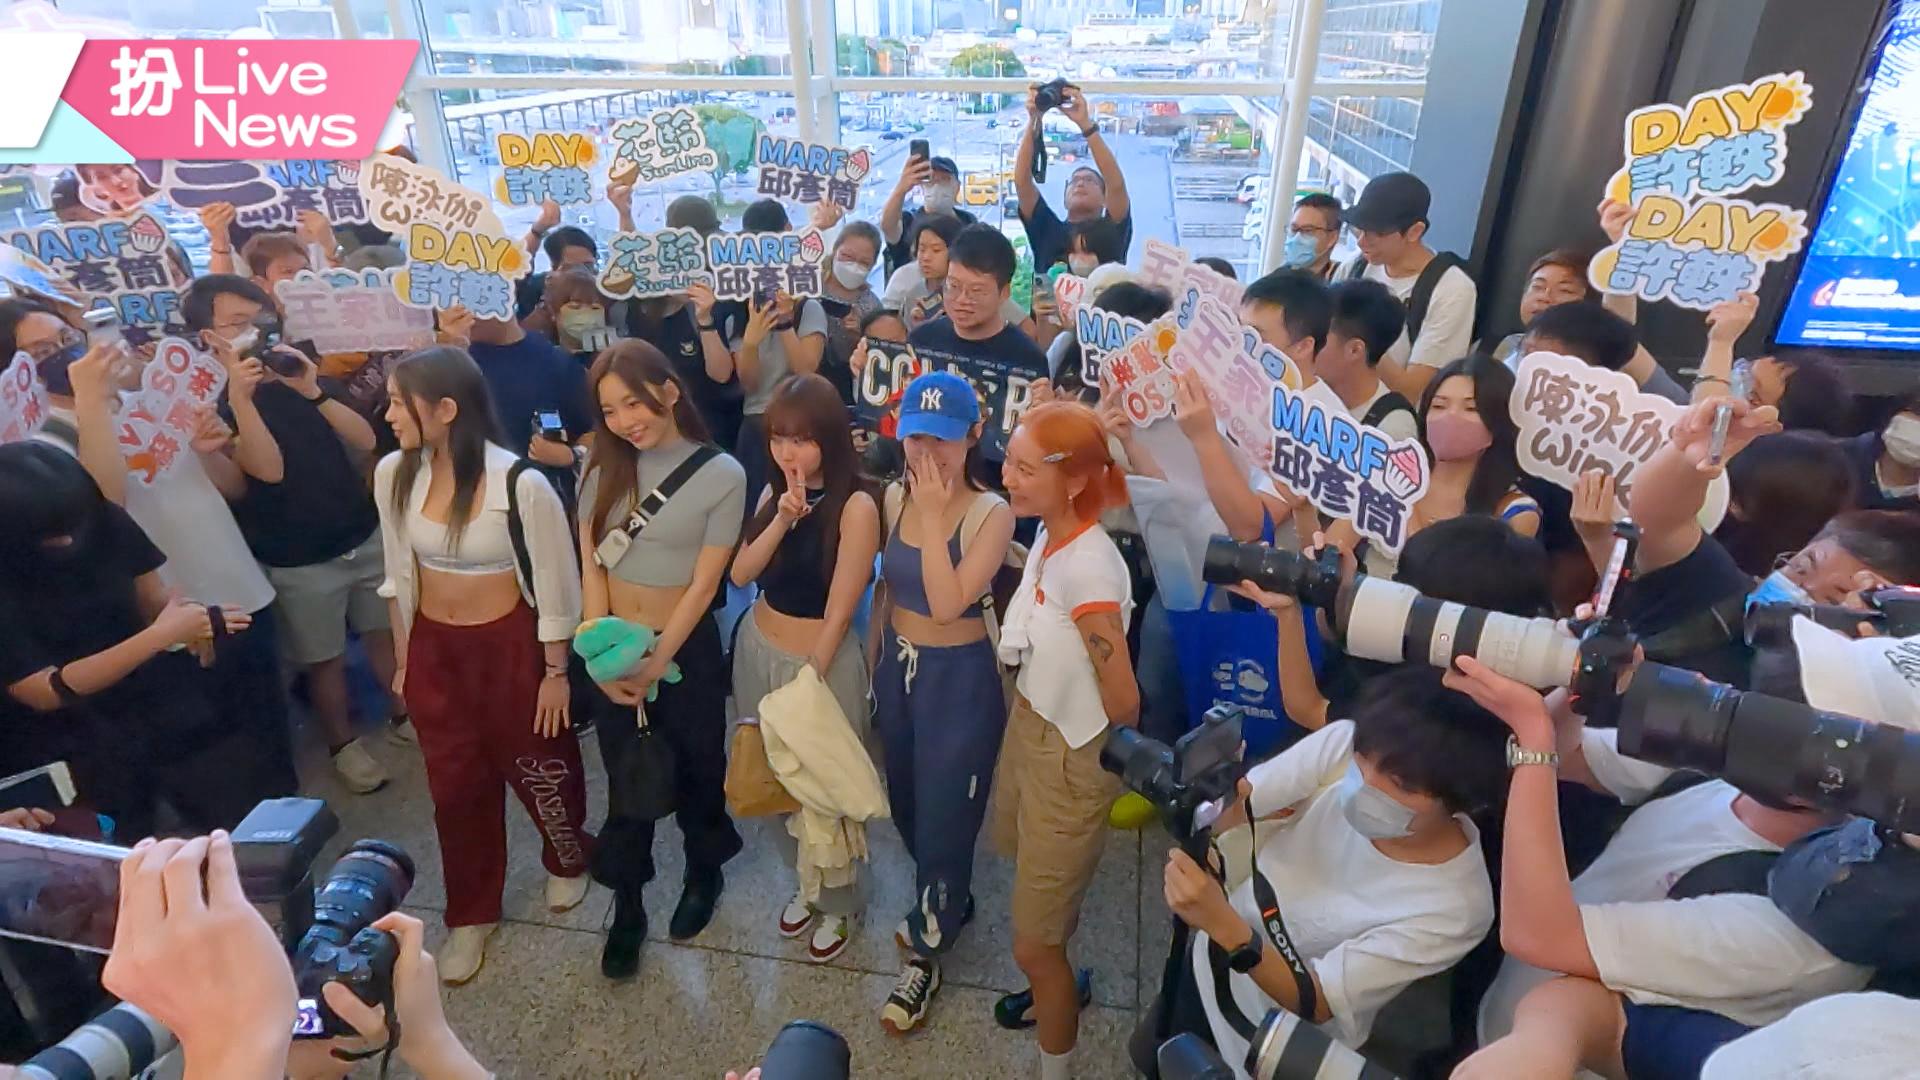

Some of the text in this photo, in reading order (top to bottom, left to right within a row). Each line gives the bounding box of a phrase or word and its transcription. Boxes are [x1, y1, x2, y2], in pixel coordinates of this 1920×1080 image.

[1631, 81, 1776, 156] DAY
[498, 132, 582, 167] DAY
[759, 135, 849, 177] MARF
[409, 223, 511, 274] DAY
[1628, 195, 1781, 252] DAY
[64, 254, 171, 294] 彥筒
[710, 234, 801, 267] MARF
[1078, 309, 1143, 351] MA
[862, 348, 1033, 434] COR
[1181, 310, 1274, 424] 王家
[920, 387, 943, 410] NY
[1272, 387, 1389, 480] MARF
[1268, 919, 1305, 974] SONY
